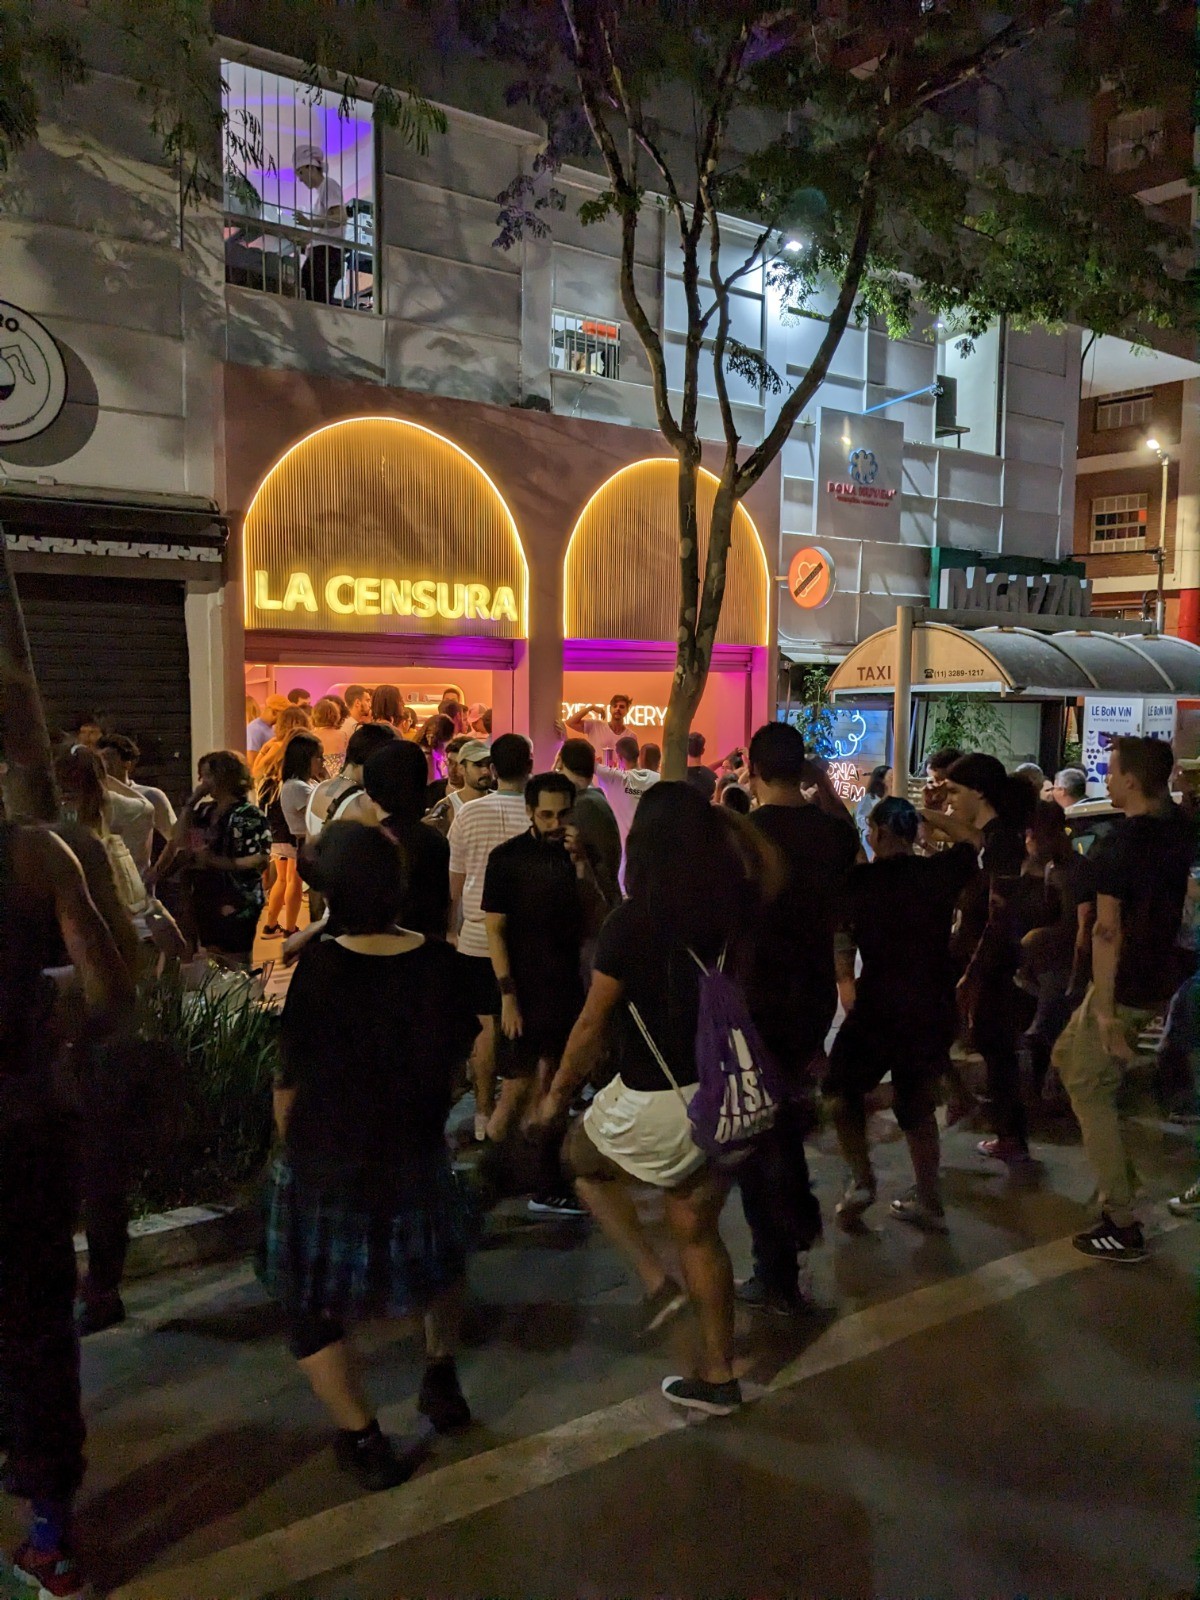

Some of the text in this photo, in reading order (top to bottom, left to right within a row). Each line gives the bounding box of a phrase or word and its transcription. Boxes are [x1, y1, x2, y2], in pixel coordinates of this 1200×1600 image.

[255, 569, 518, 621] LA CENSURA
[857, 665, 891, 681] TAXI
[948, 669, 985, 677] 3289-1217
[607, 704, 668, 726] KERY
[1091, 706, 1099, 716] LE
